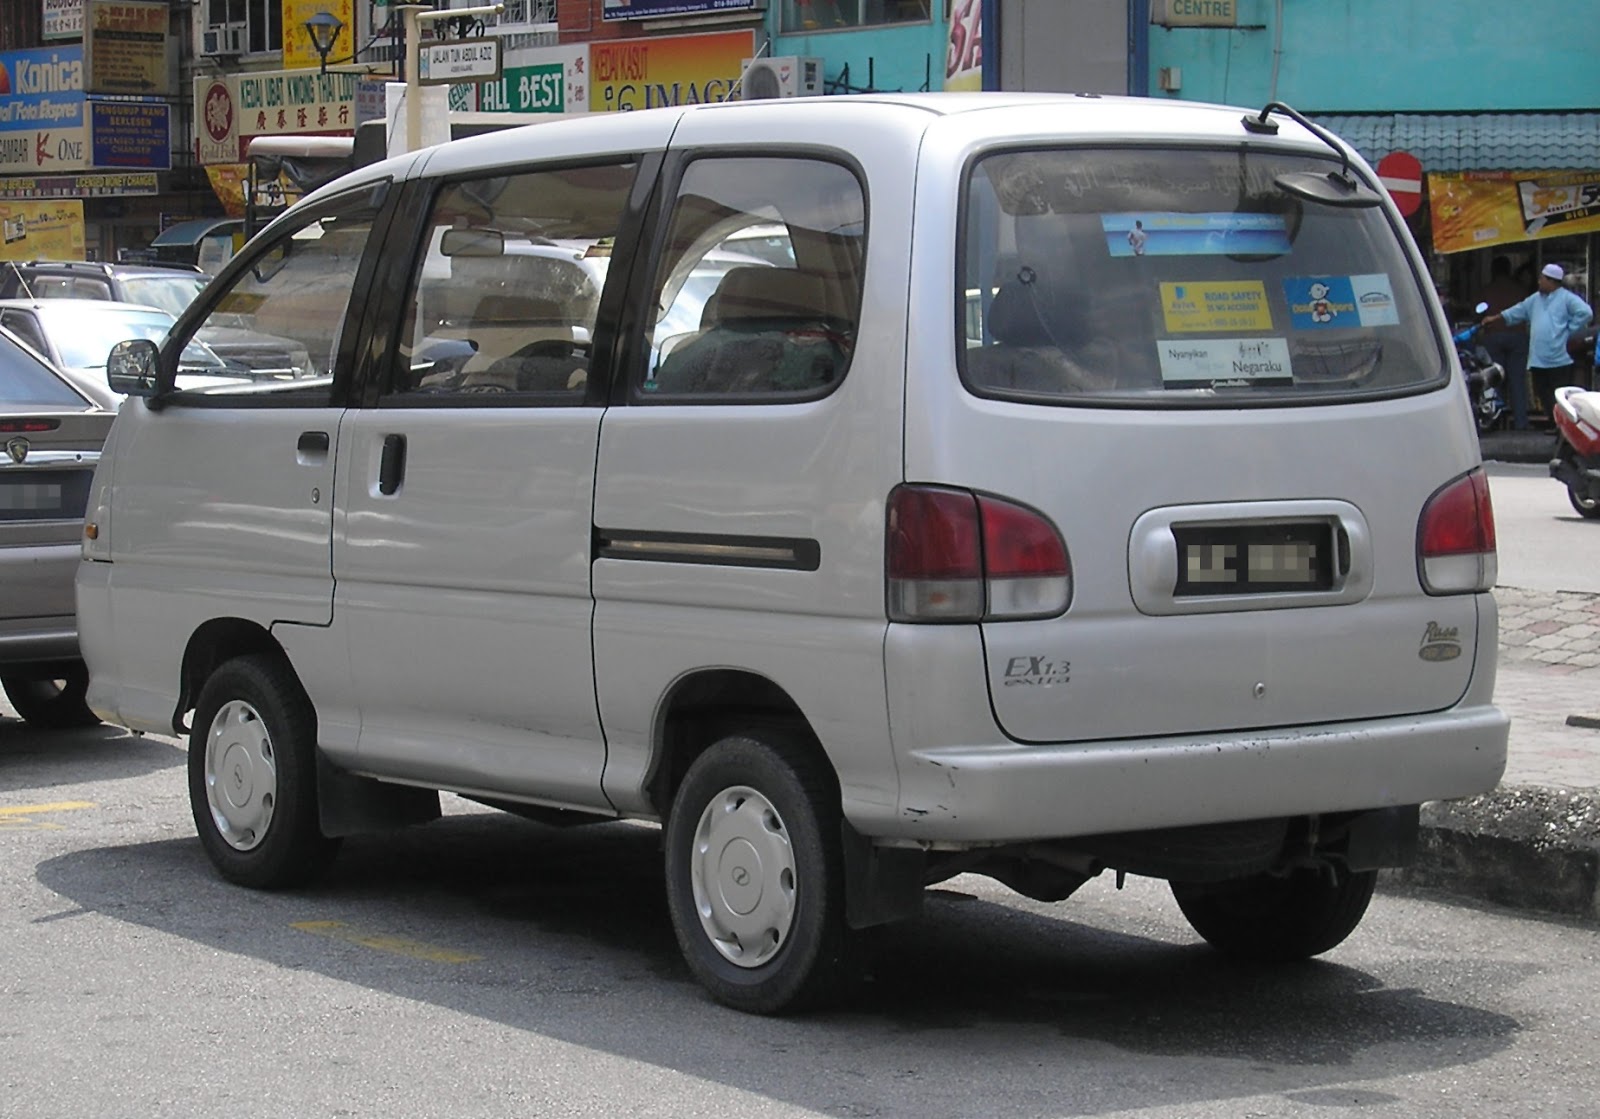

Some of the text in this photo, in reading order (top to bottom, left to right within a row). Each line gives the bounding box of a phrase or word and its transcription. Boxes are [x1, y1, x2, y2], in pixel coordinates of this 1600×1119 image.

[1173, 0, 1232, 16] CENTRE
[433, 46, 492, 64] JALAN TUN ABDUL AZIZ
[594, 46, 649, 82] KEDAI KASUT
[16, 54, 83, 94] Konica
[241, 78, 263, 109] KEDAI
[265, 76, 284, 107] UBAT
[287, 74, 315, 105] KWONG
[317, 73, 335, 103] THAI
[483, 79, 510, 111] ALL
[518, 73, 562, 109] BEST
[36, 132, 55, 166] K
[1204, 290, 1262, 302] ROAD SAFETY
[1168, 348, 1208, 361] Nyanyikan
[1232, 360, 1282, 376] Negaraku
[1420, 620, 1460, 647] Rusa
